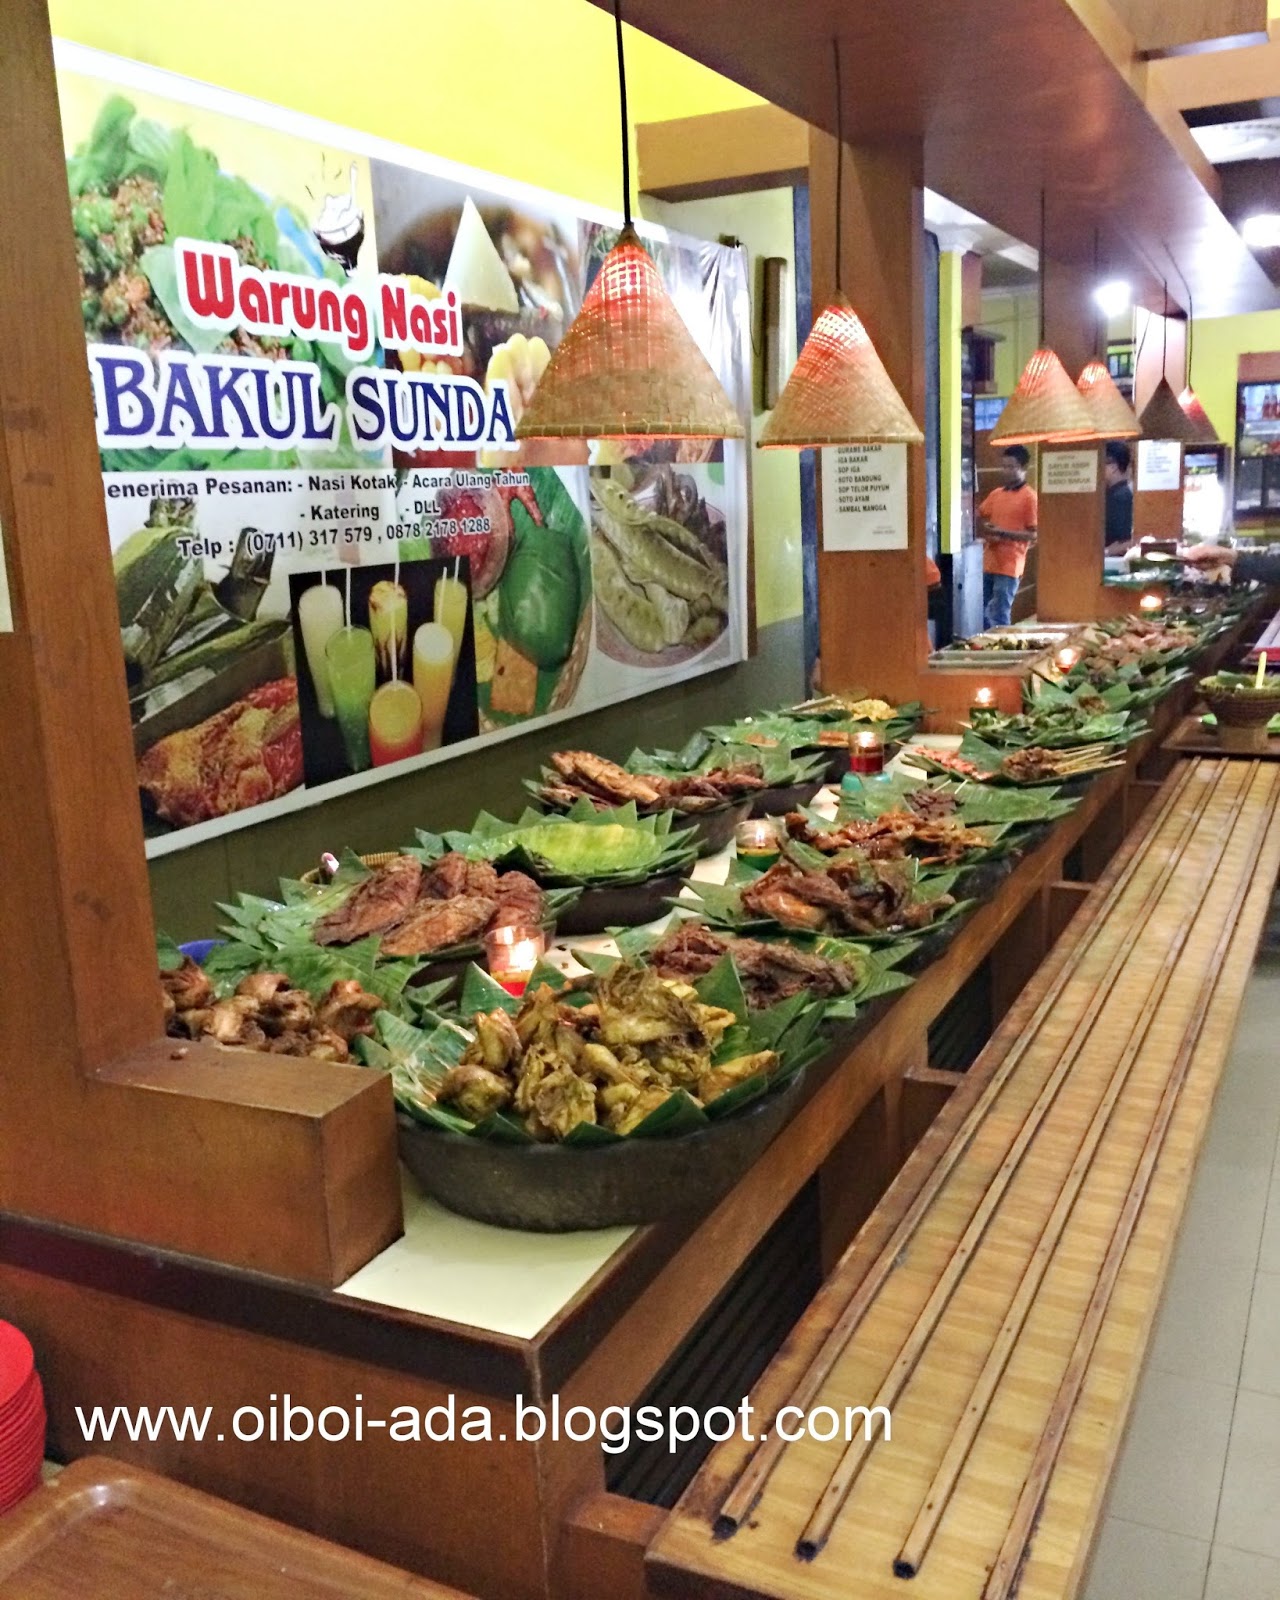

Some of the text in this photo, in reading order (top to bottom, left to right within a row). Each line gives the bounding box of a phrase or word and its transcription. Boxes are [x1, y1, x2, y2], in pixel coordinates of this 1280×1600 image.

[183, 250, 459, 351] Warung Nasi
[96, 357, 516, 443] BAKUL SUNDA
[107, 478, 198, 498] enerima
[205, 478, 293, 494] Pesanan:
[308, 475, 345, 491] Nasi
[351, 475, 397, 490] Kotak
[412, 474, 451, 488] Acara
[456, 473, 491, 488] Ulang
[494, 472, 530, 486] Tahun
[311, 505, 380, 521] Katering
[414, 500, 440, 514] DLL
[178, 539, 222, 559] Telp
[246, 531, 303, 556] (0711)
[309, 529, 338, 546] 317
[344, 526, 372, 543] 579
[386, 523, 421, 540] 0878
[425, 520, 457, 537] 2178
[461, 518, 491, 534] 1288
